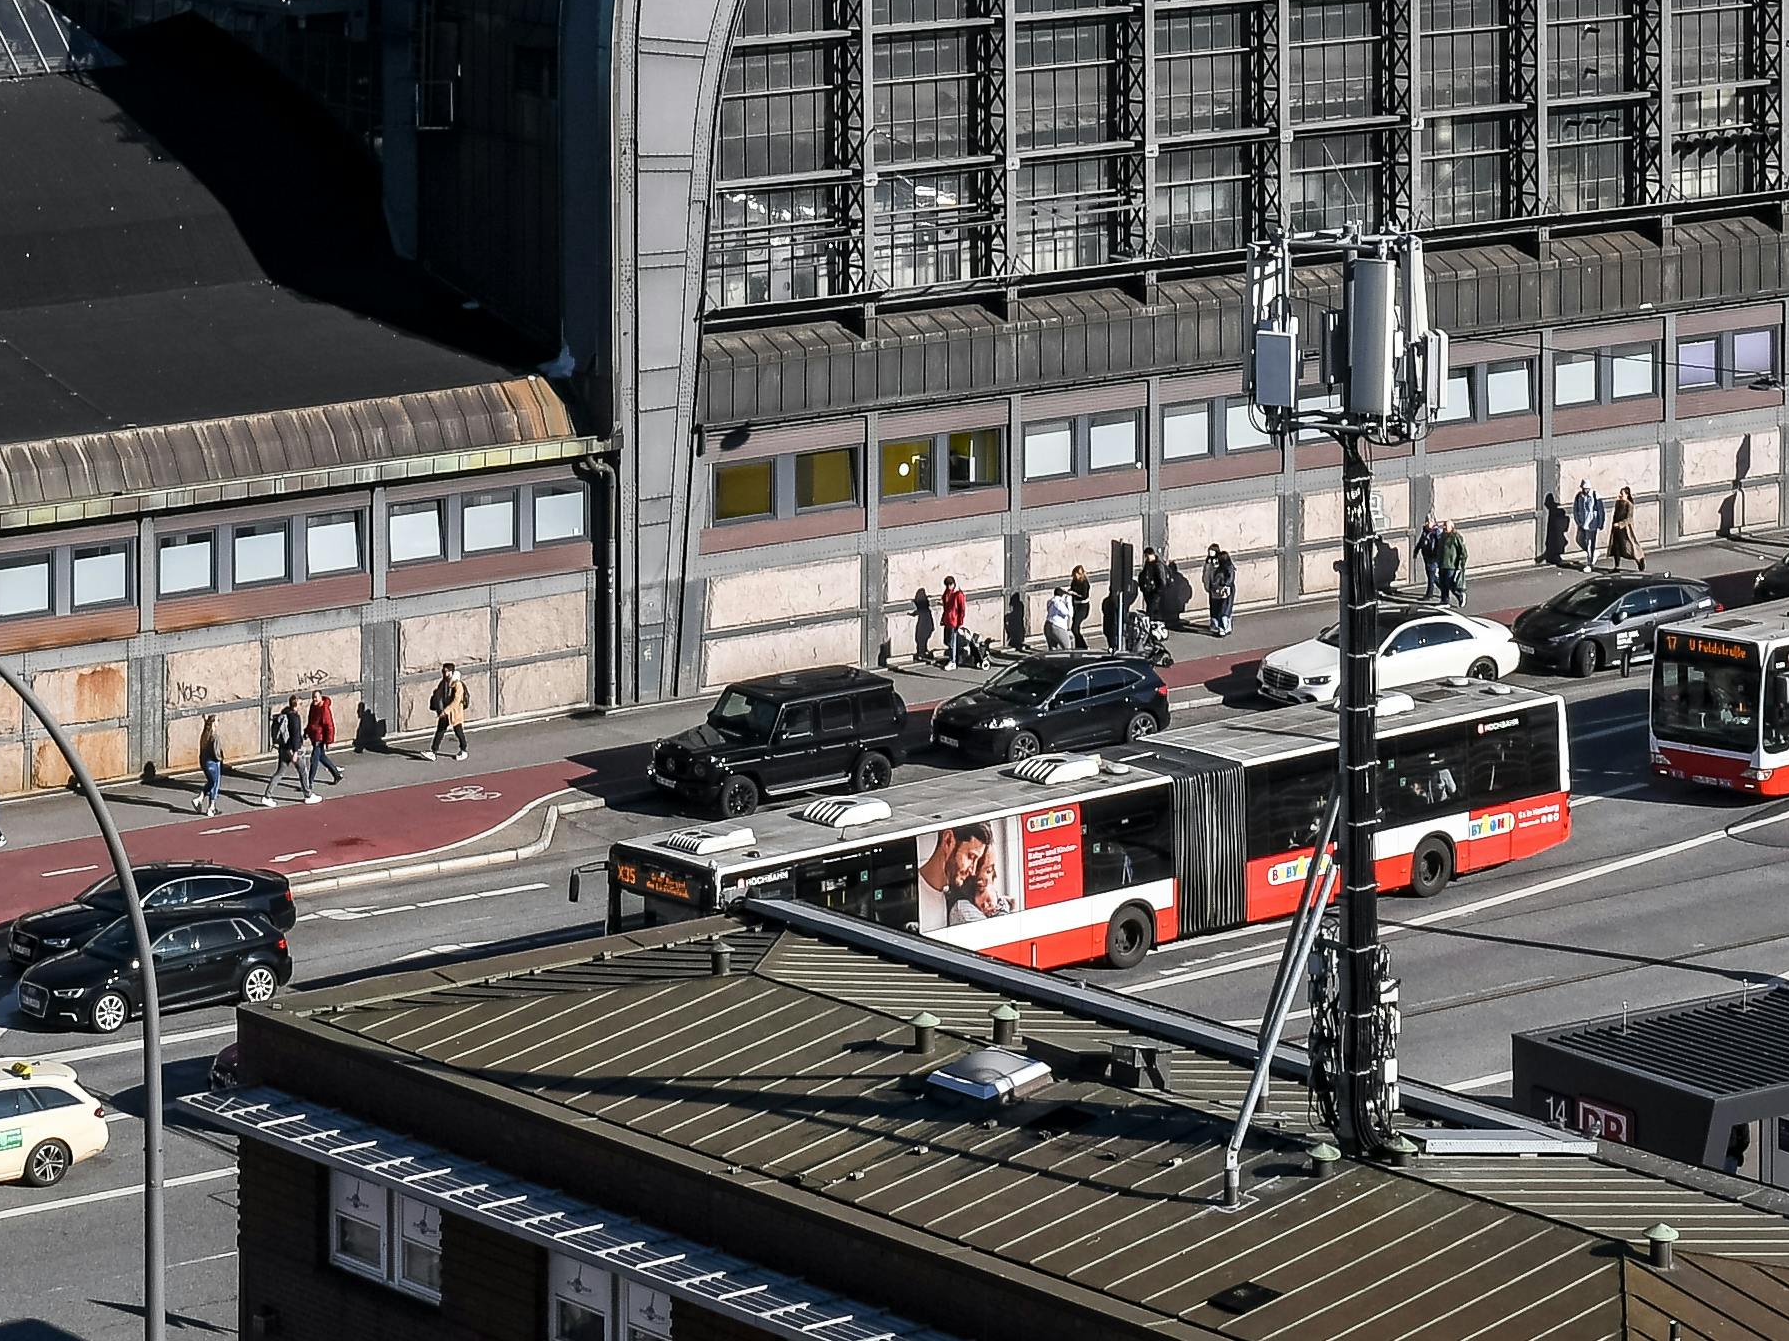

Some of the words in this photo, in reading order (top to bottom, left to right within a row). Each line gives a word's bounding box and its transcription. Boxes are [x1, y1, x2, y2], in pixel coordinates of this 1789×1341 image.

[1666, 635, 1677, 650] 17
[1689, 638, 1696, 651] U
[1545, 1095, 1568, 1123] 14
